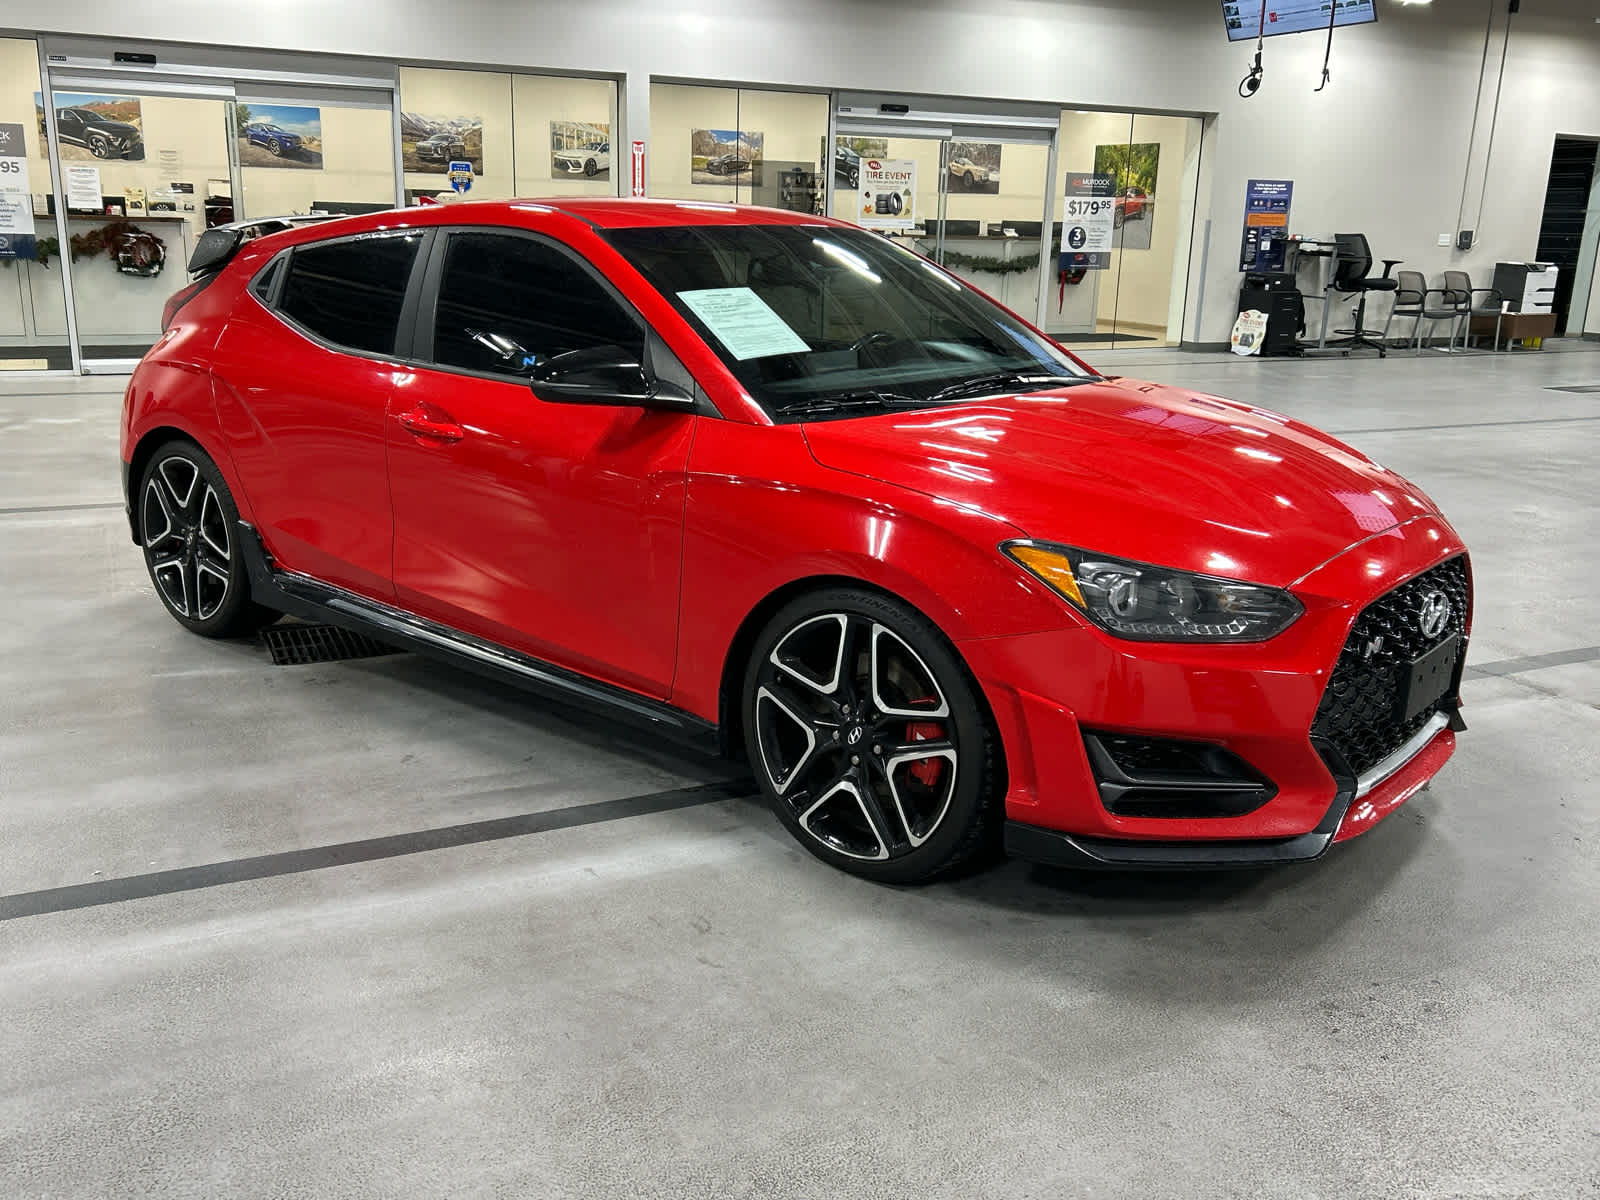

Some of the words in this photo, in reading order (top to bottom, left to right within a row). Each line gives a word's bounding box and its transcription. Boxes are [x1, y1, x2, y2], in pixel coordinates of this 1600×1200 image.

[865, 171, 883, 180] TIRE
[885, 171, 913, 180] EVENT
[1082, 177, 1110, 186] MURDOCK
[1073, 229, 1082, 241] 3
